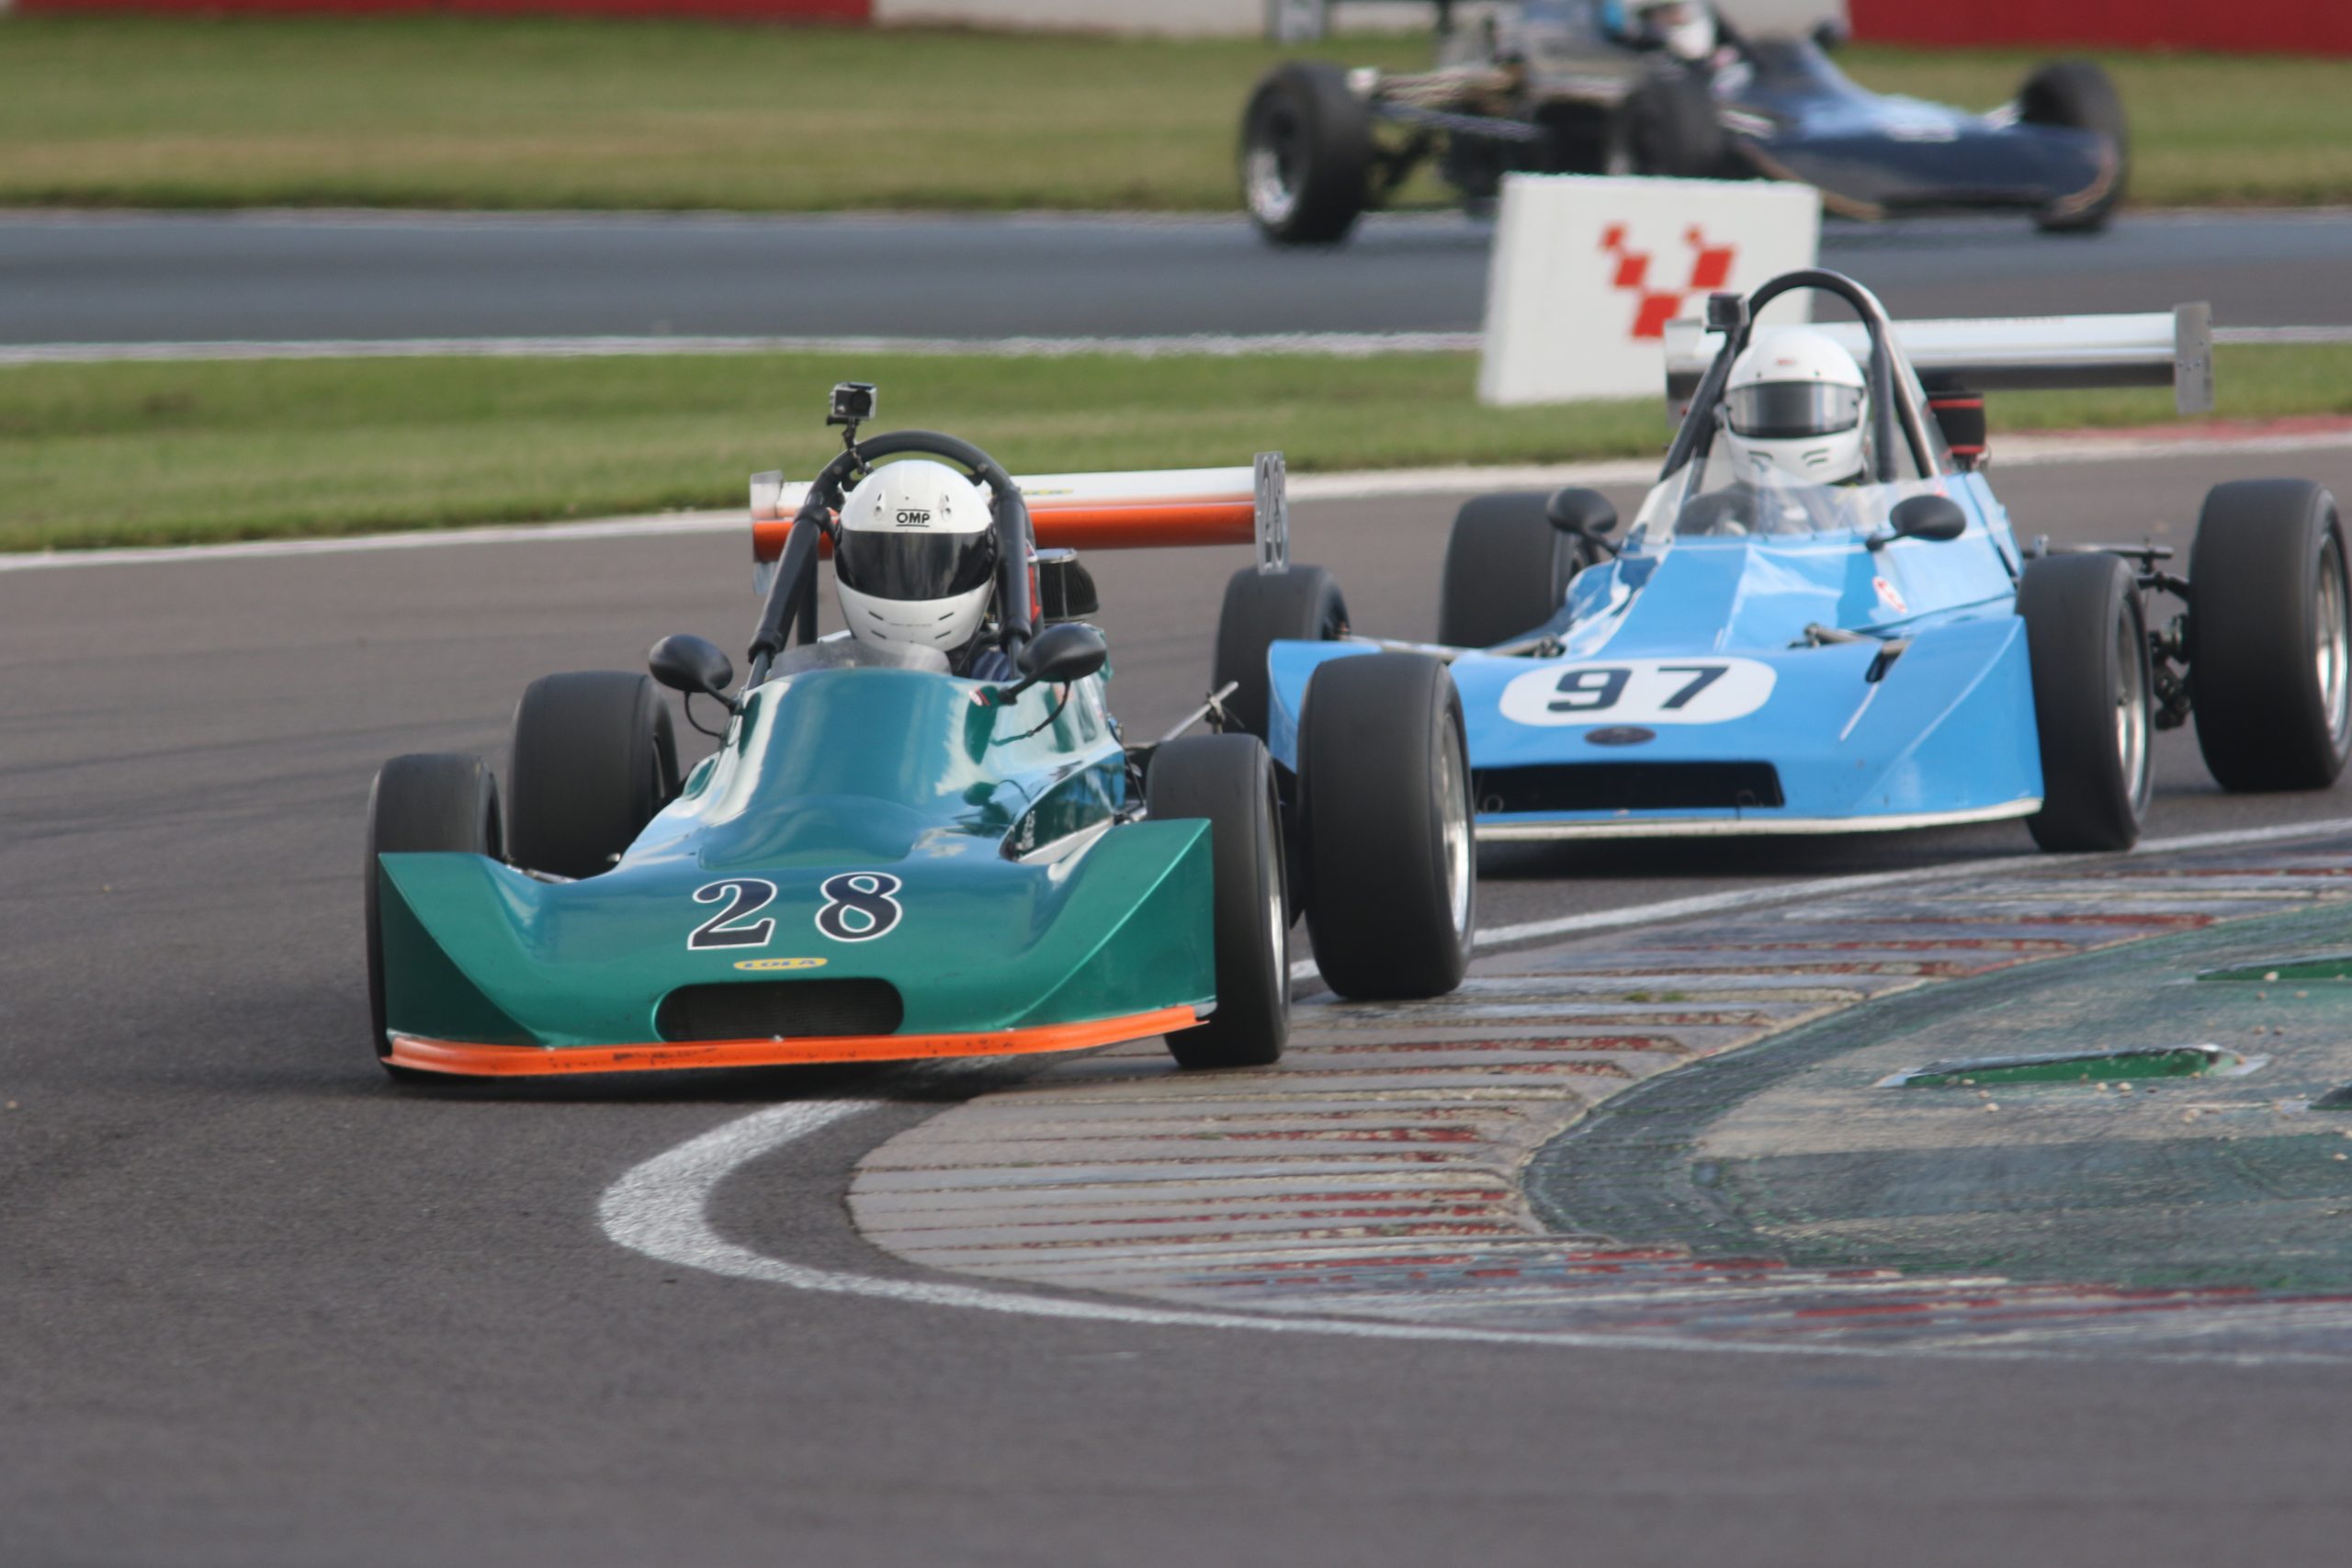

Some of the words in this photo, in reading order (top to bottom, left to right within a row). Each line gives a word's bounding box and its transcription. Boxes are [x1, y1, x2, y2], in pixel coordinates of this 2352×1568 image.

[897, 512, 931, 524] OMP
[1547, 665, 1729, 713] 97
[687, 871, 903, 950] 28
